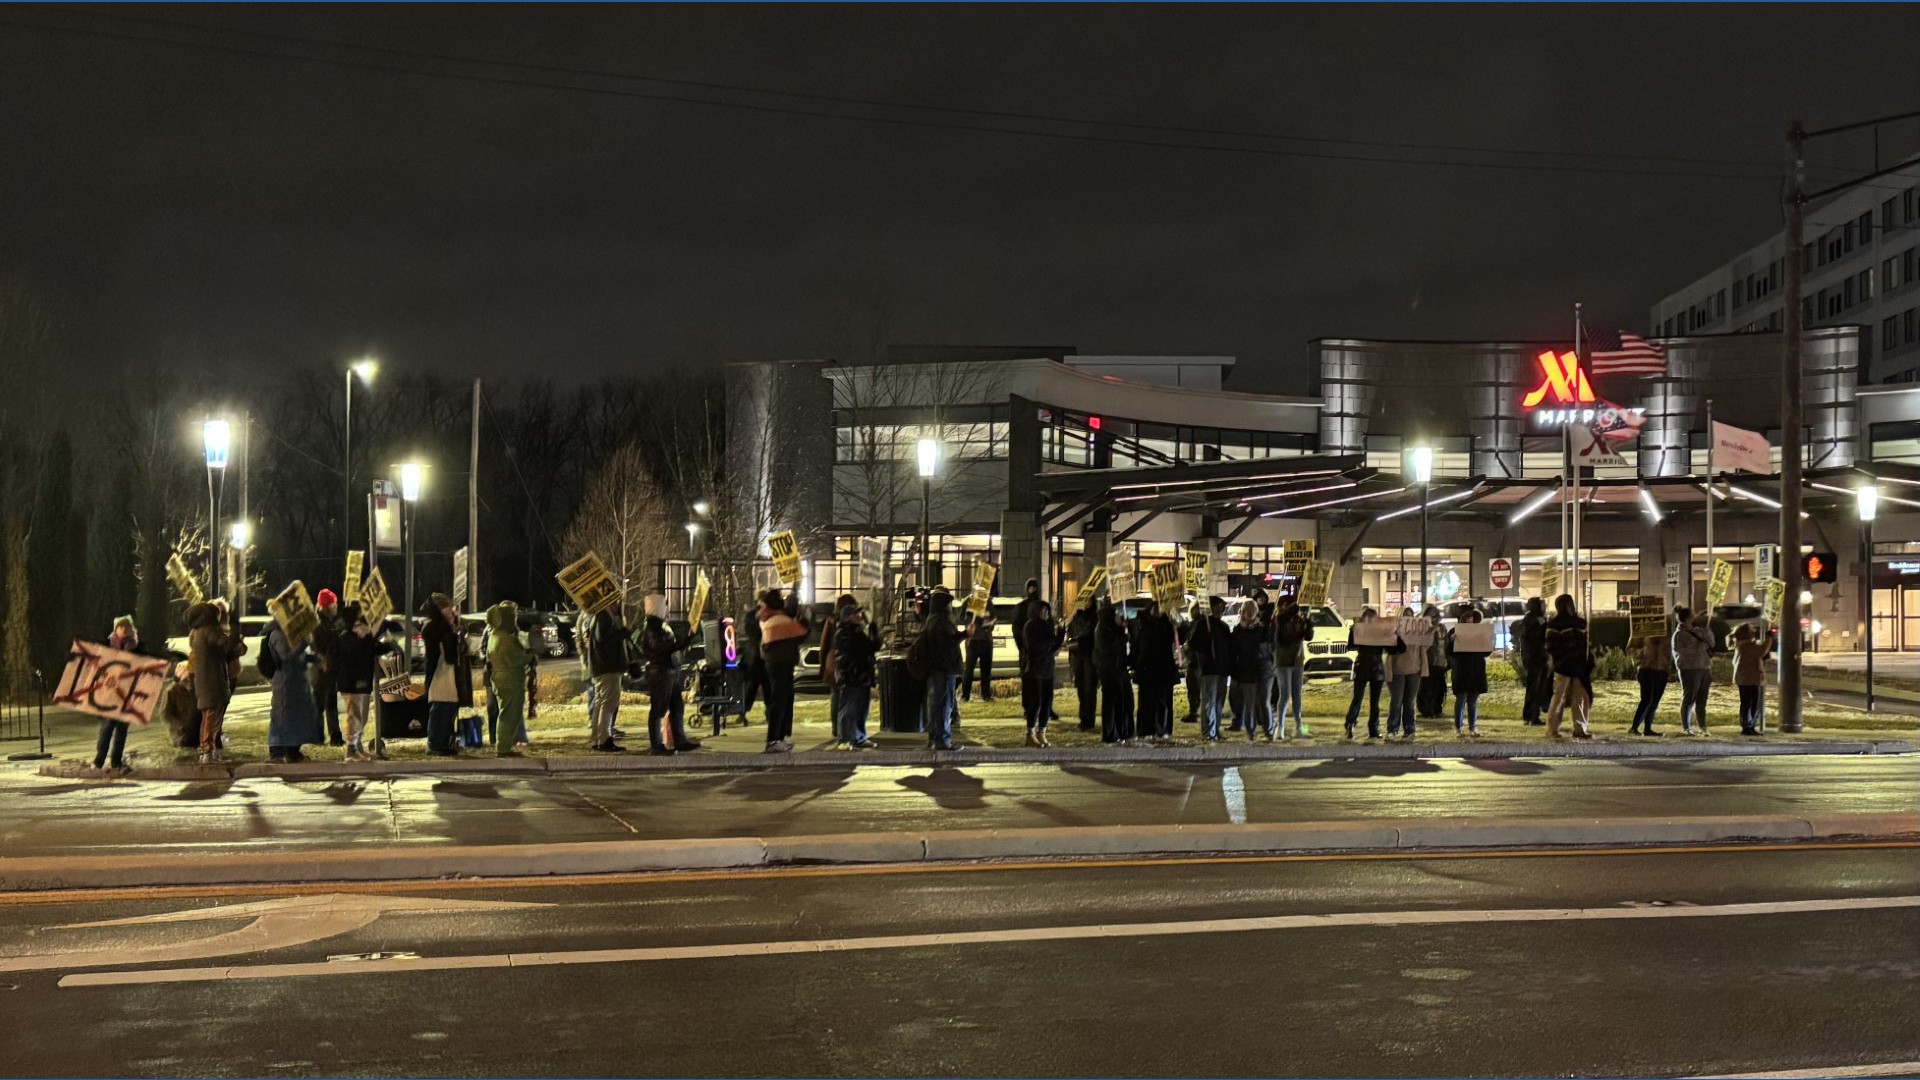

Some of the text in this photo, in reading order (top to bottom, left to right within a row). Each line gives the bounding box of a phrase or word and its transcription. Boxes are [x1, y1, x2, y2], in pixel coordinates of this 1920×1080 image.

[768, 533, 793, 558] STOP
[1186, 551, 1208, 569] STOP
[64, 651, 164, 713] ICE
